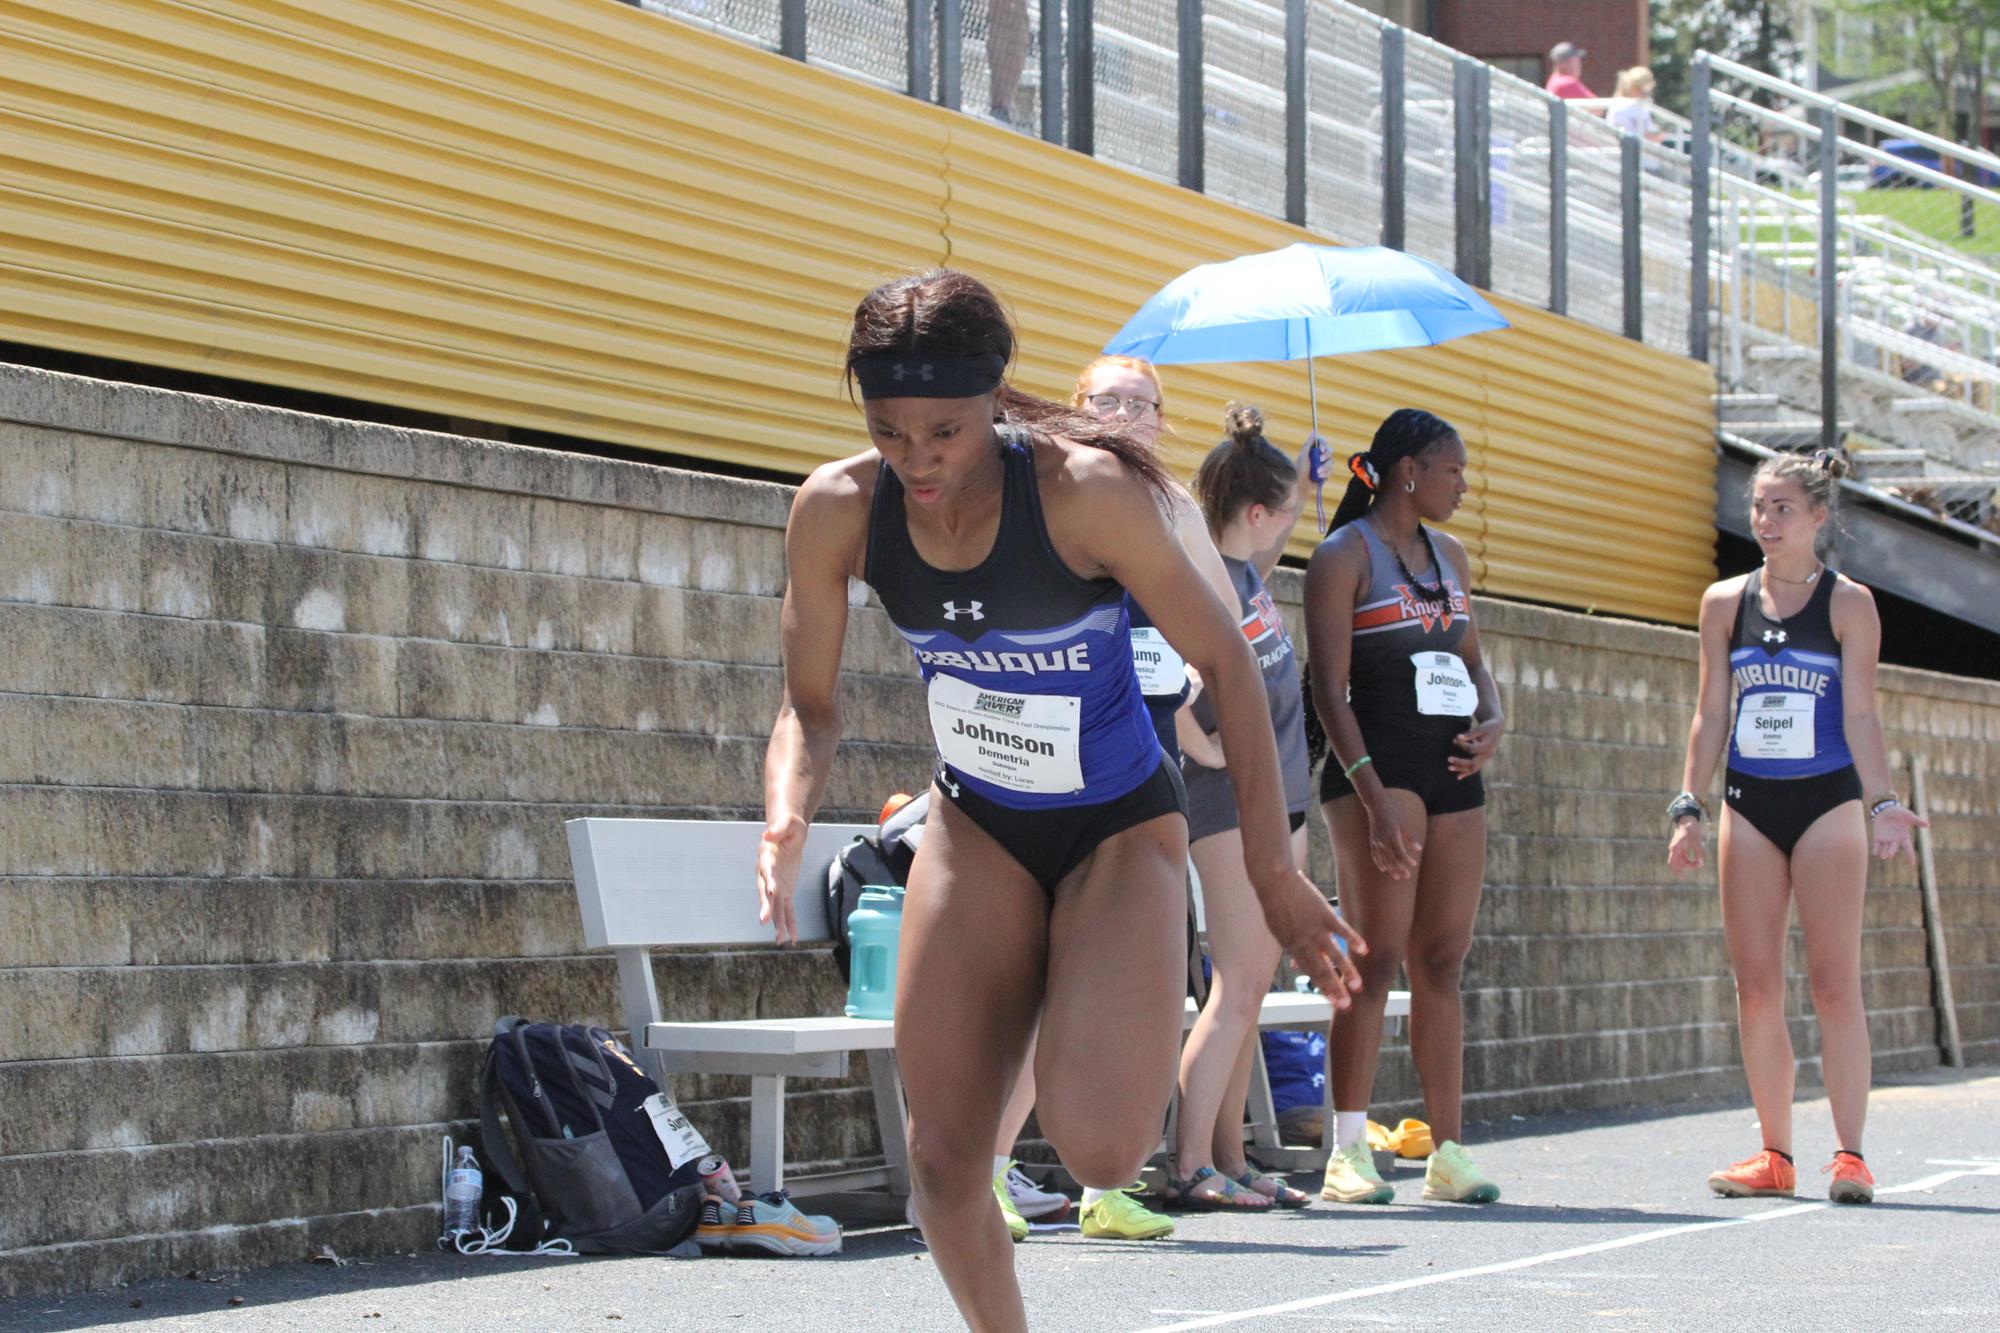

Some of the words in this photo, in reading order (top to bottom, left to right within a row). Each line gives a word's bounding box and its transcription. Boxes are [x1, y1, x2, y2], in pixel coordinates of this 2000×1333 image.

[1399, 597, 1465, 619] Knigts
[1134, 650, 1162, 665] ump
[978, 693, 1025, 706] AMERICAN
[1755, 716, 1793, 732] Seipel
[951, 718, 1055, 757] Johnson
[978, 745, 1030, 767] Demetria
